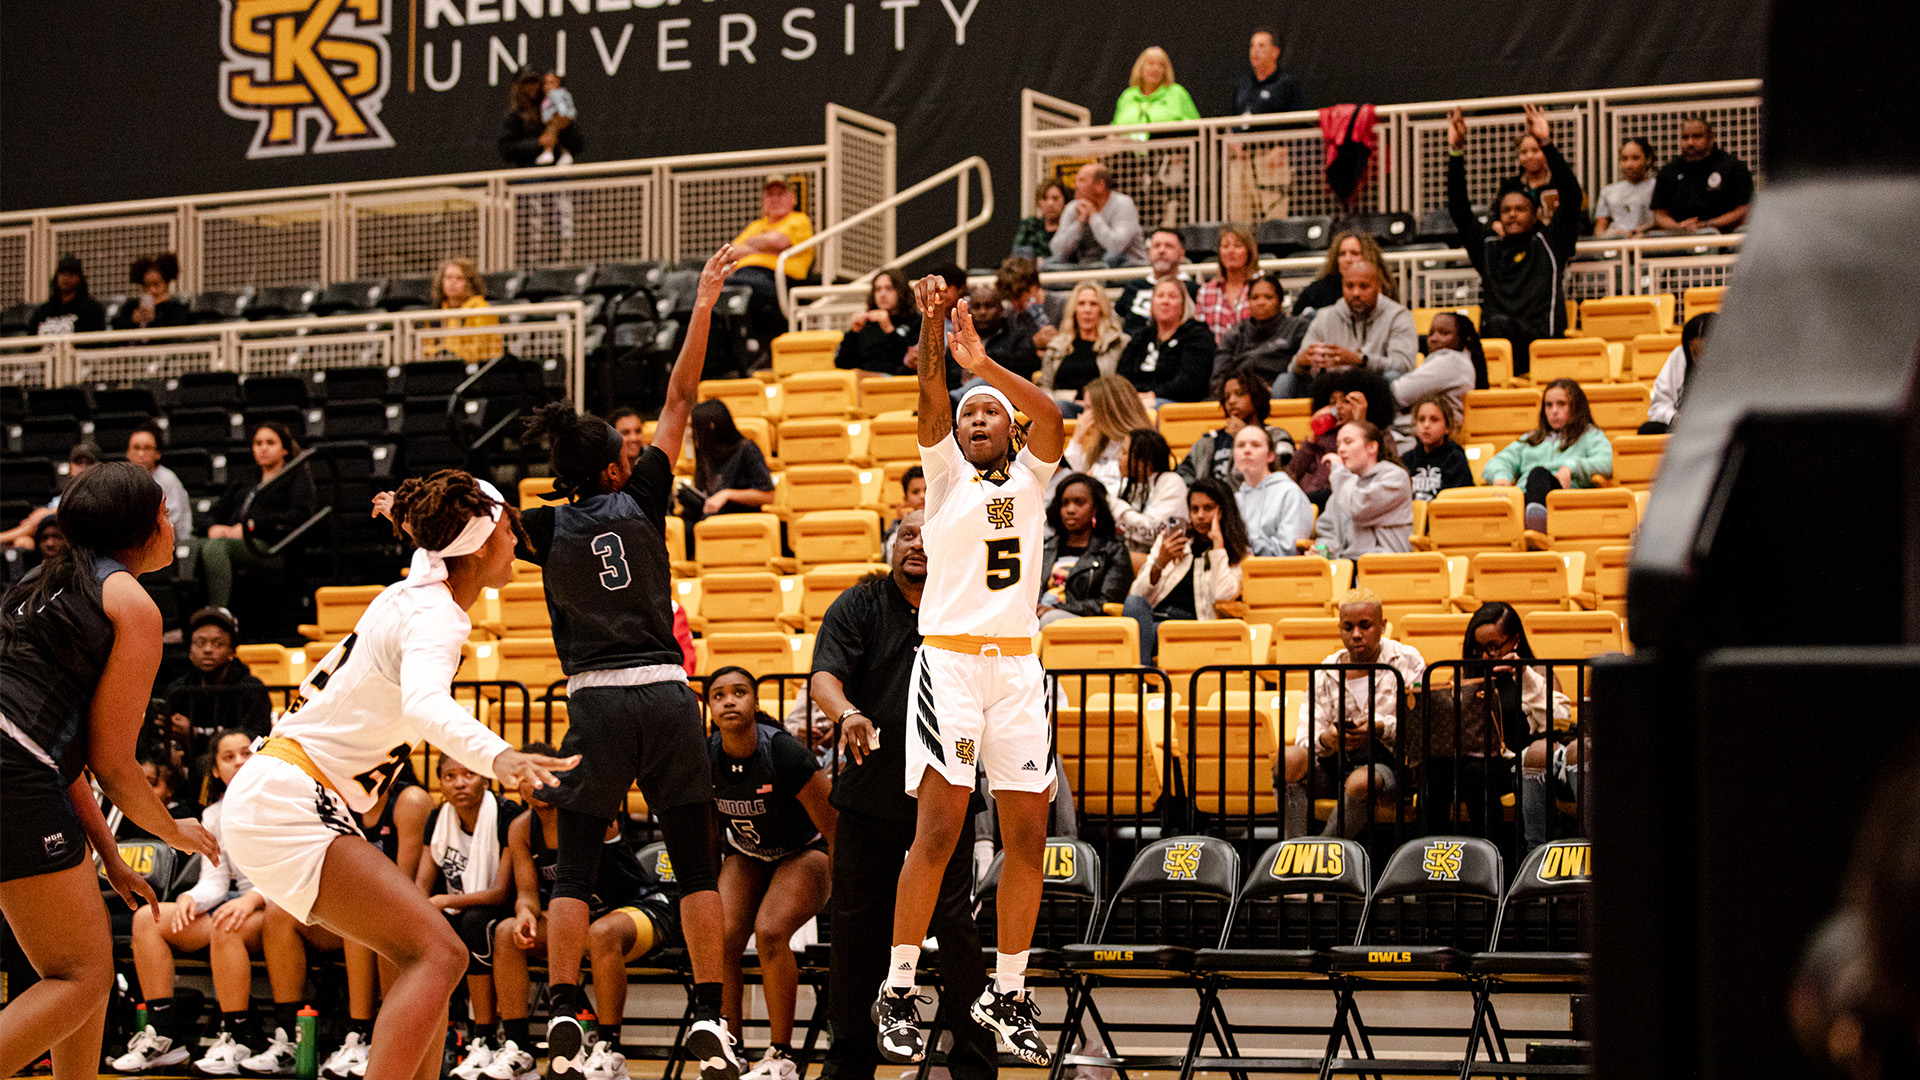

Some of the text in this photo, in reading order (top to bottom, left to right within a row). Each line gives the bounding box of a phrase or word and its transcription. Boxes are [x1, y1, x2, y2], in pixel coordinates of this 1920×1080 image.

[424, 0, 980, 92] UNIVERSITY
[590, 531, 632, 591] 3
[982, 535, 1022, 592] 5
[1272, 843, 1343, 875] OWLS
[1093, 950, 1134, 961] OWLS
[1368, 951, 1412, 963] OWLS
